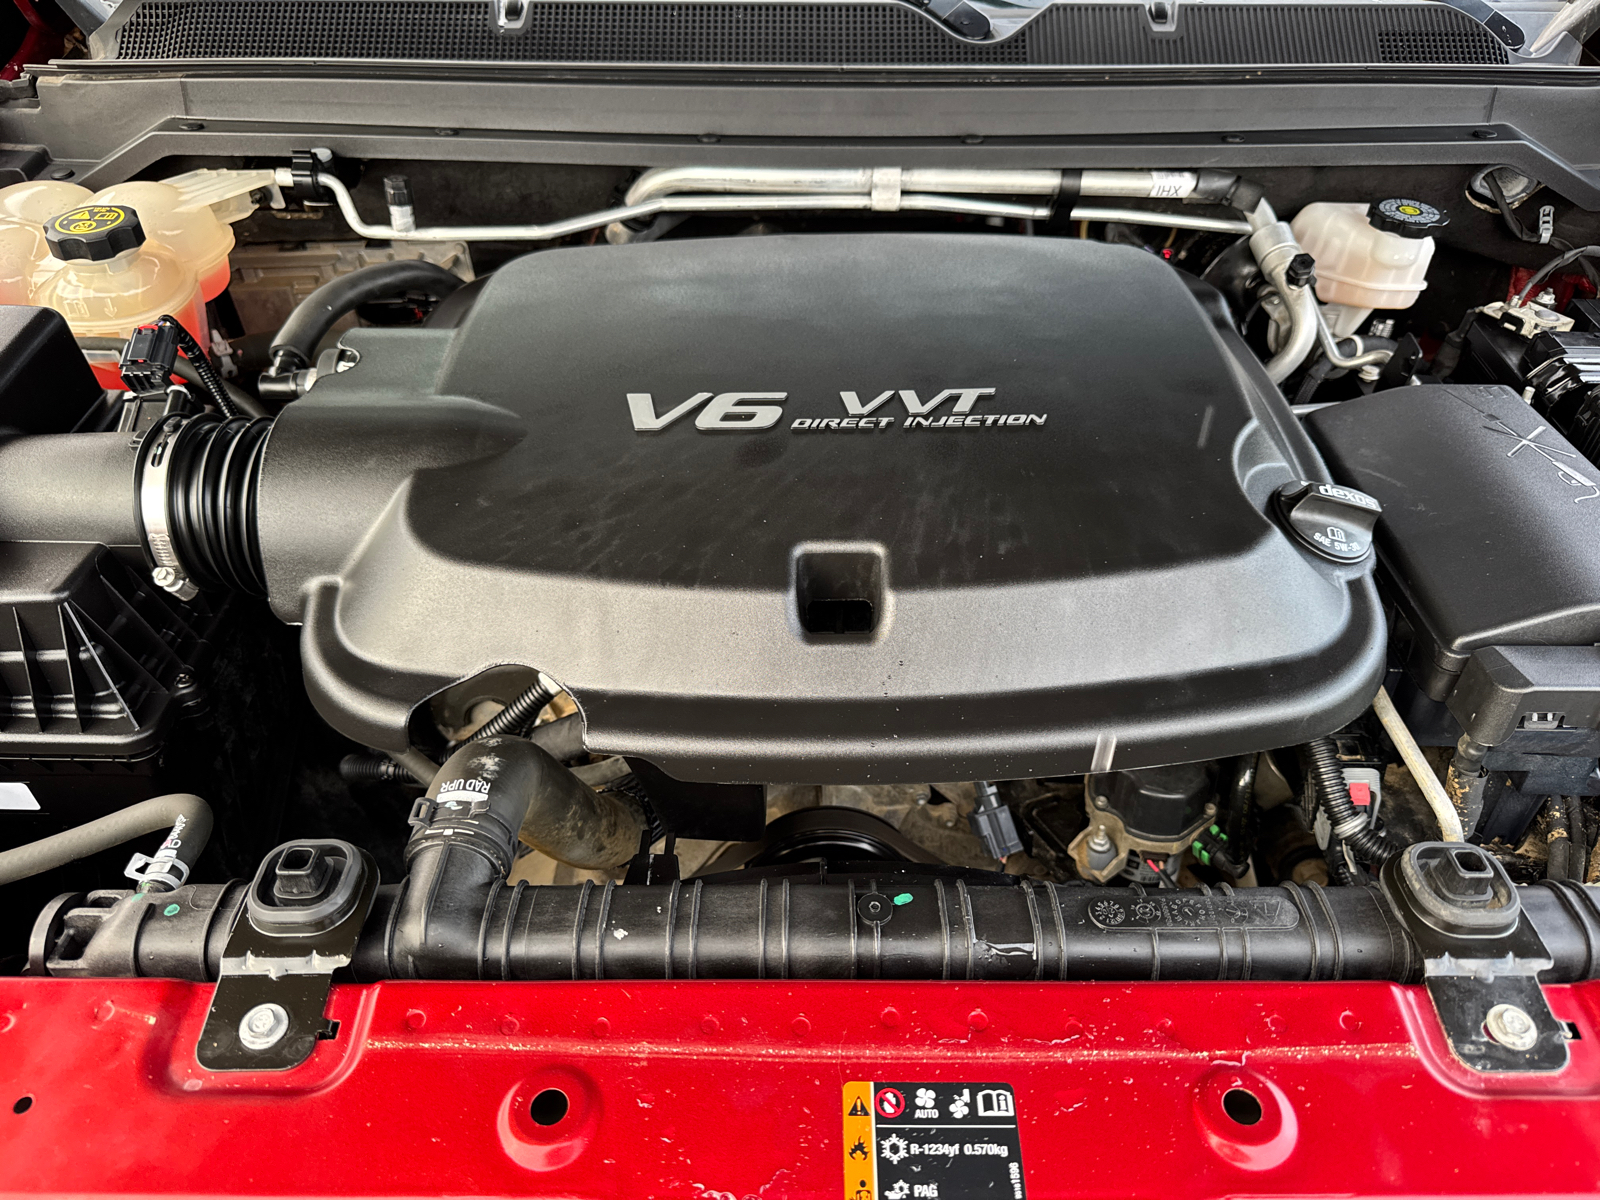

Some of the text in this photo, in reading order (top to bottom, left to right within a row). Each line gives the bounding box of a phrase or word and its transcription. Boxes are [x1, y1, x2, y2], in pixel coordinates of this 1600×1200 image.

[840, 387, 996, 416] VVT
[626, 391, 788, 432] V6
[790, 413, 1047, 430] DIRECT INJECTION
[1318, 484, 1377, 509] dexos
[1313, 532, 1361, 552] SAE 5W-30
[441, 779, 491, 793] RAD UPR
[914, 1109, 939, 1119] AUTO
[910, 1143, 1009, 1157] R-1234yf 0.570kg
[913, 1184, 938, 1198] PAG
